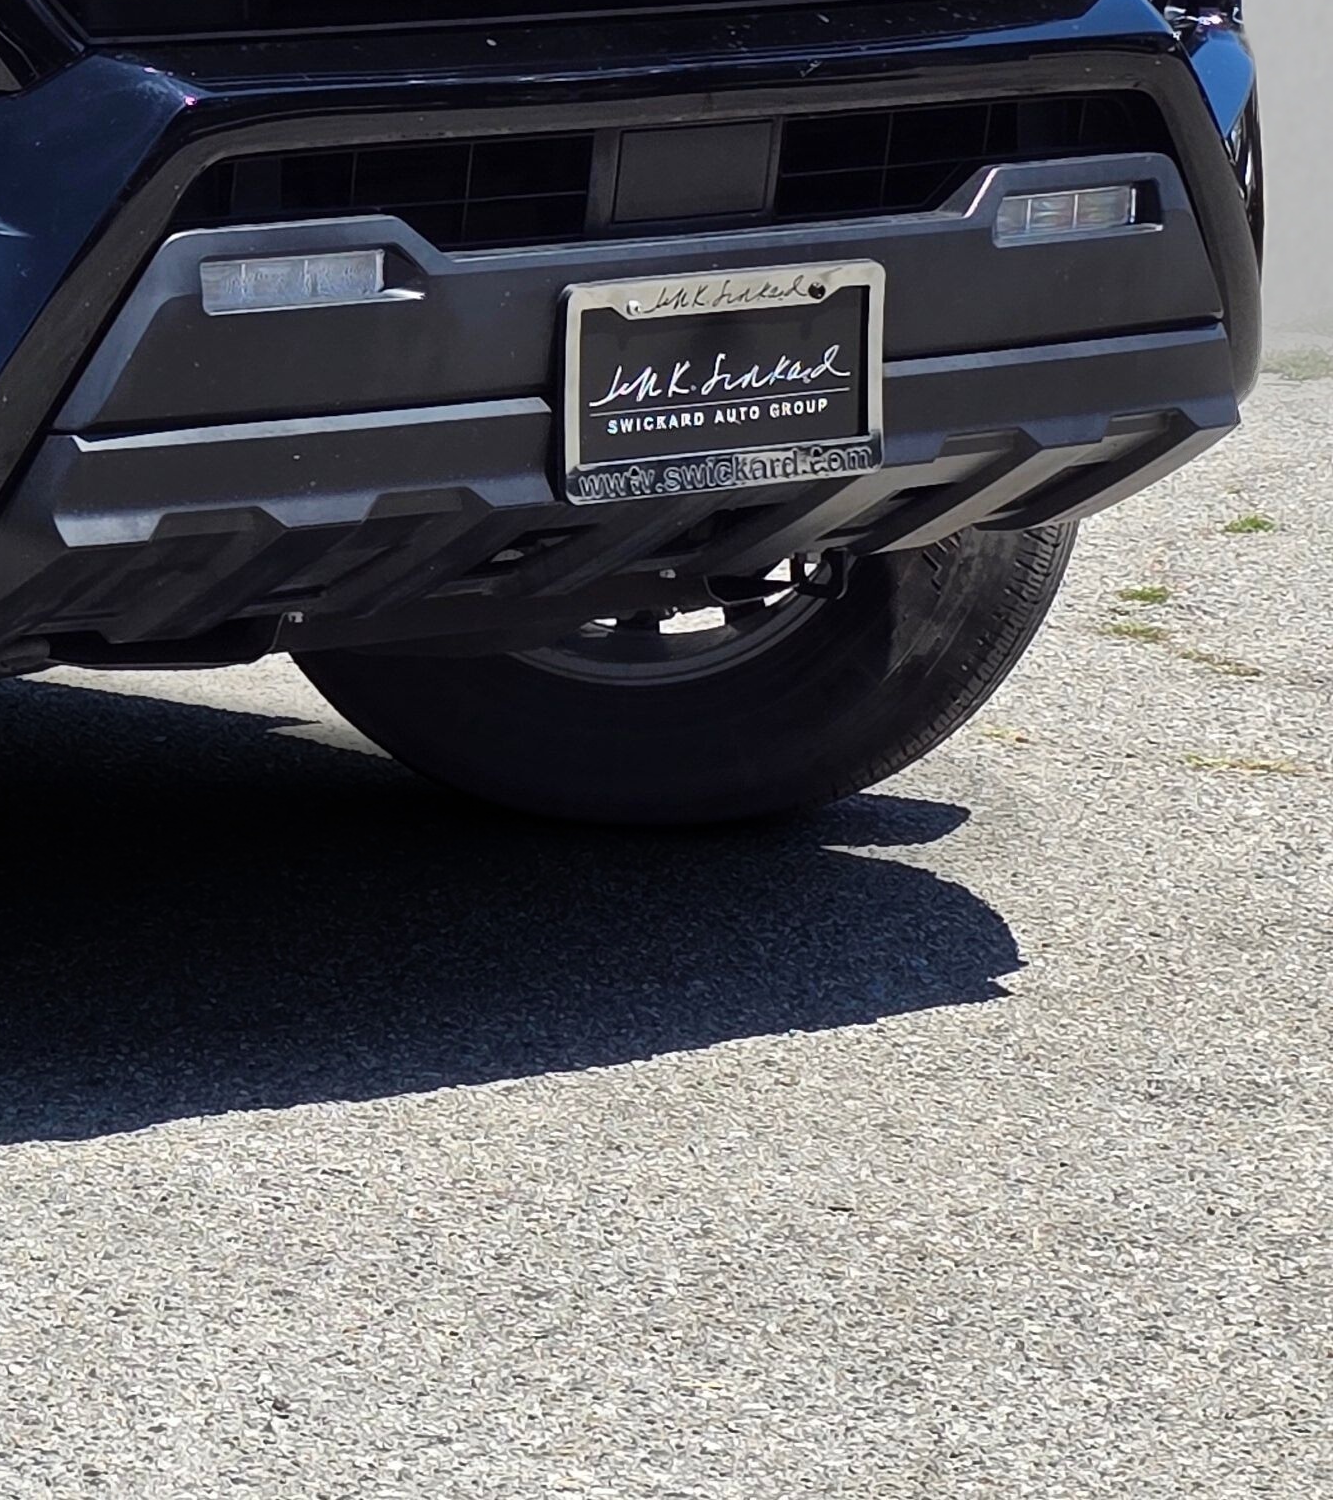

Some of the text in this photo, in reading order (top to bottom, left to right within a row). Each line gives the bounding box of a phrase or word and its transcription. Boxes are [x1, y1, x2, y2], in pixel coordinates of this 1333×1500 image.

[606, 397, 829, 435] SWICKARD AUTO GROUP
[578, 444, 874, 501] www.swickard.com
